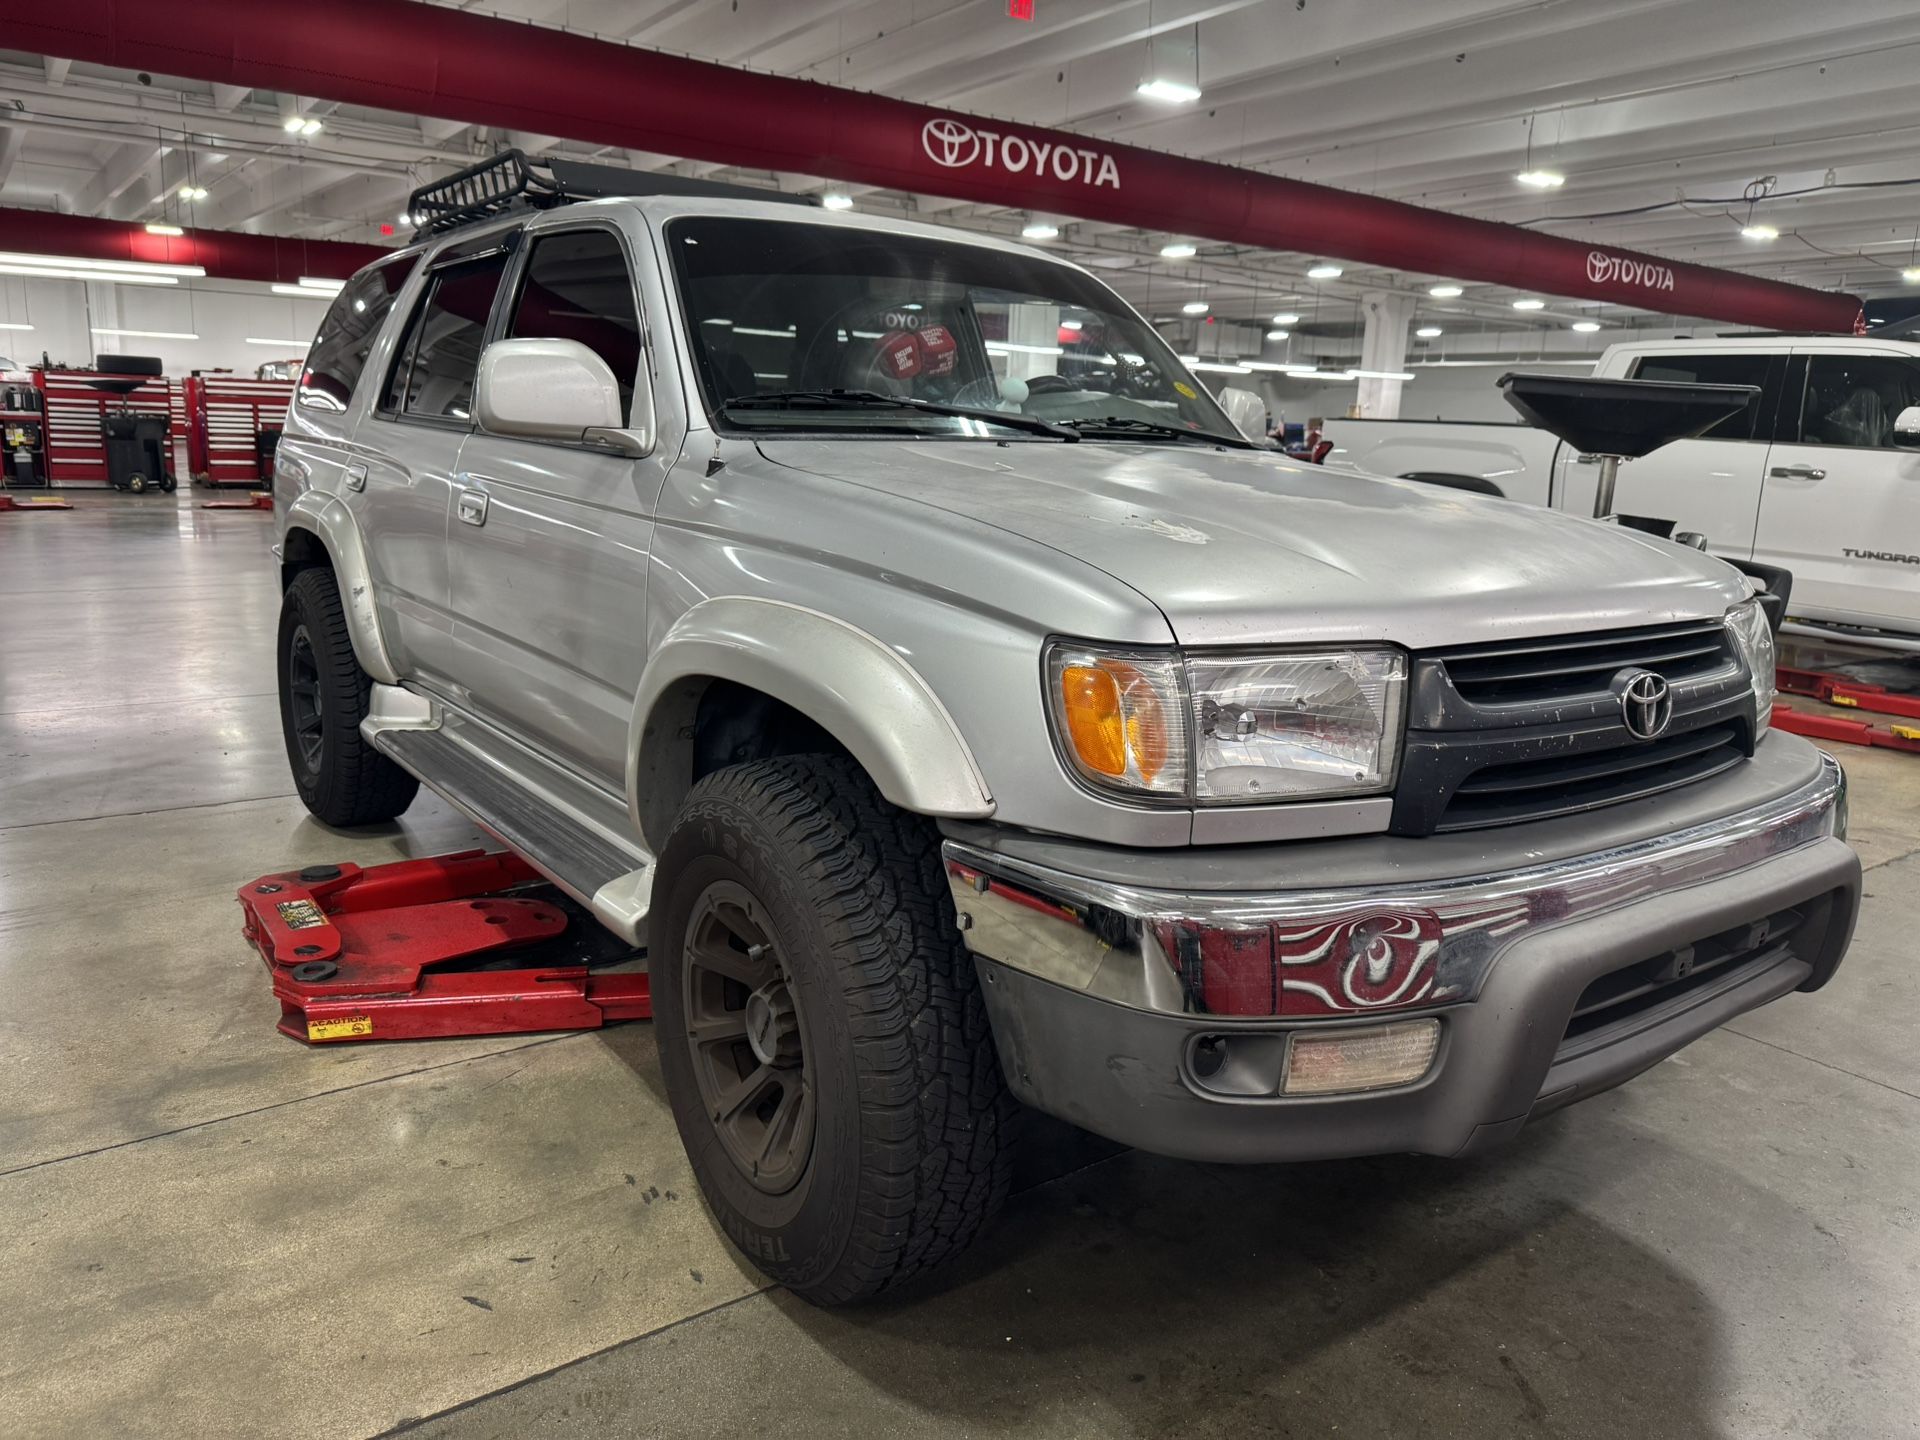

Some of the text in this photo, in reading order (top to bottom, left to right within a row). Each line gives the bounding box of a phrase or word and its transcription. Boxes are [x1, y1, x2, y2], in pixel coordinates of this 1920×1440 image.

[977, 130, 1121, 189] TOYOTA
[1611, 257, 1674, 291] TOYOTA
[1842, 548, 1920, 565] TUNDRA
[318, 1016, 367, 1027] CAUTION
